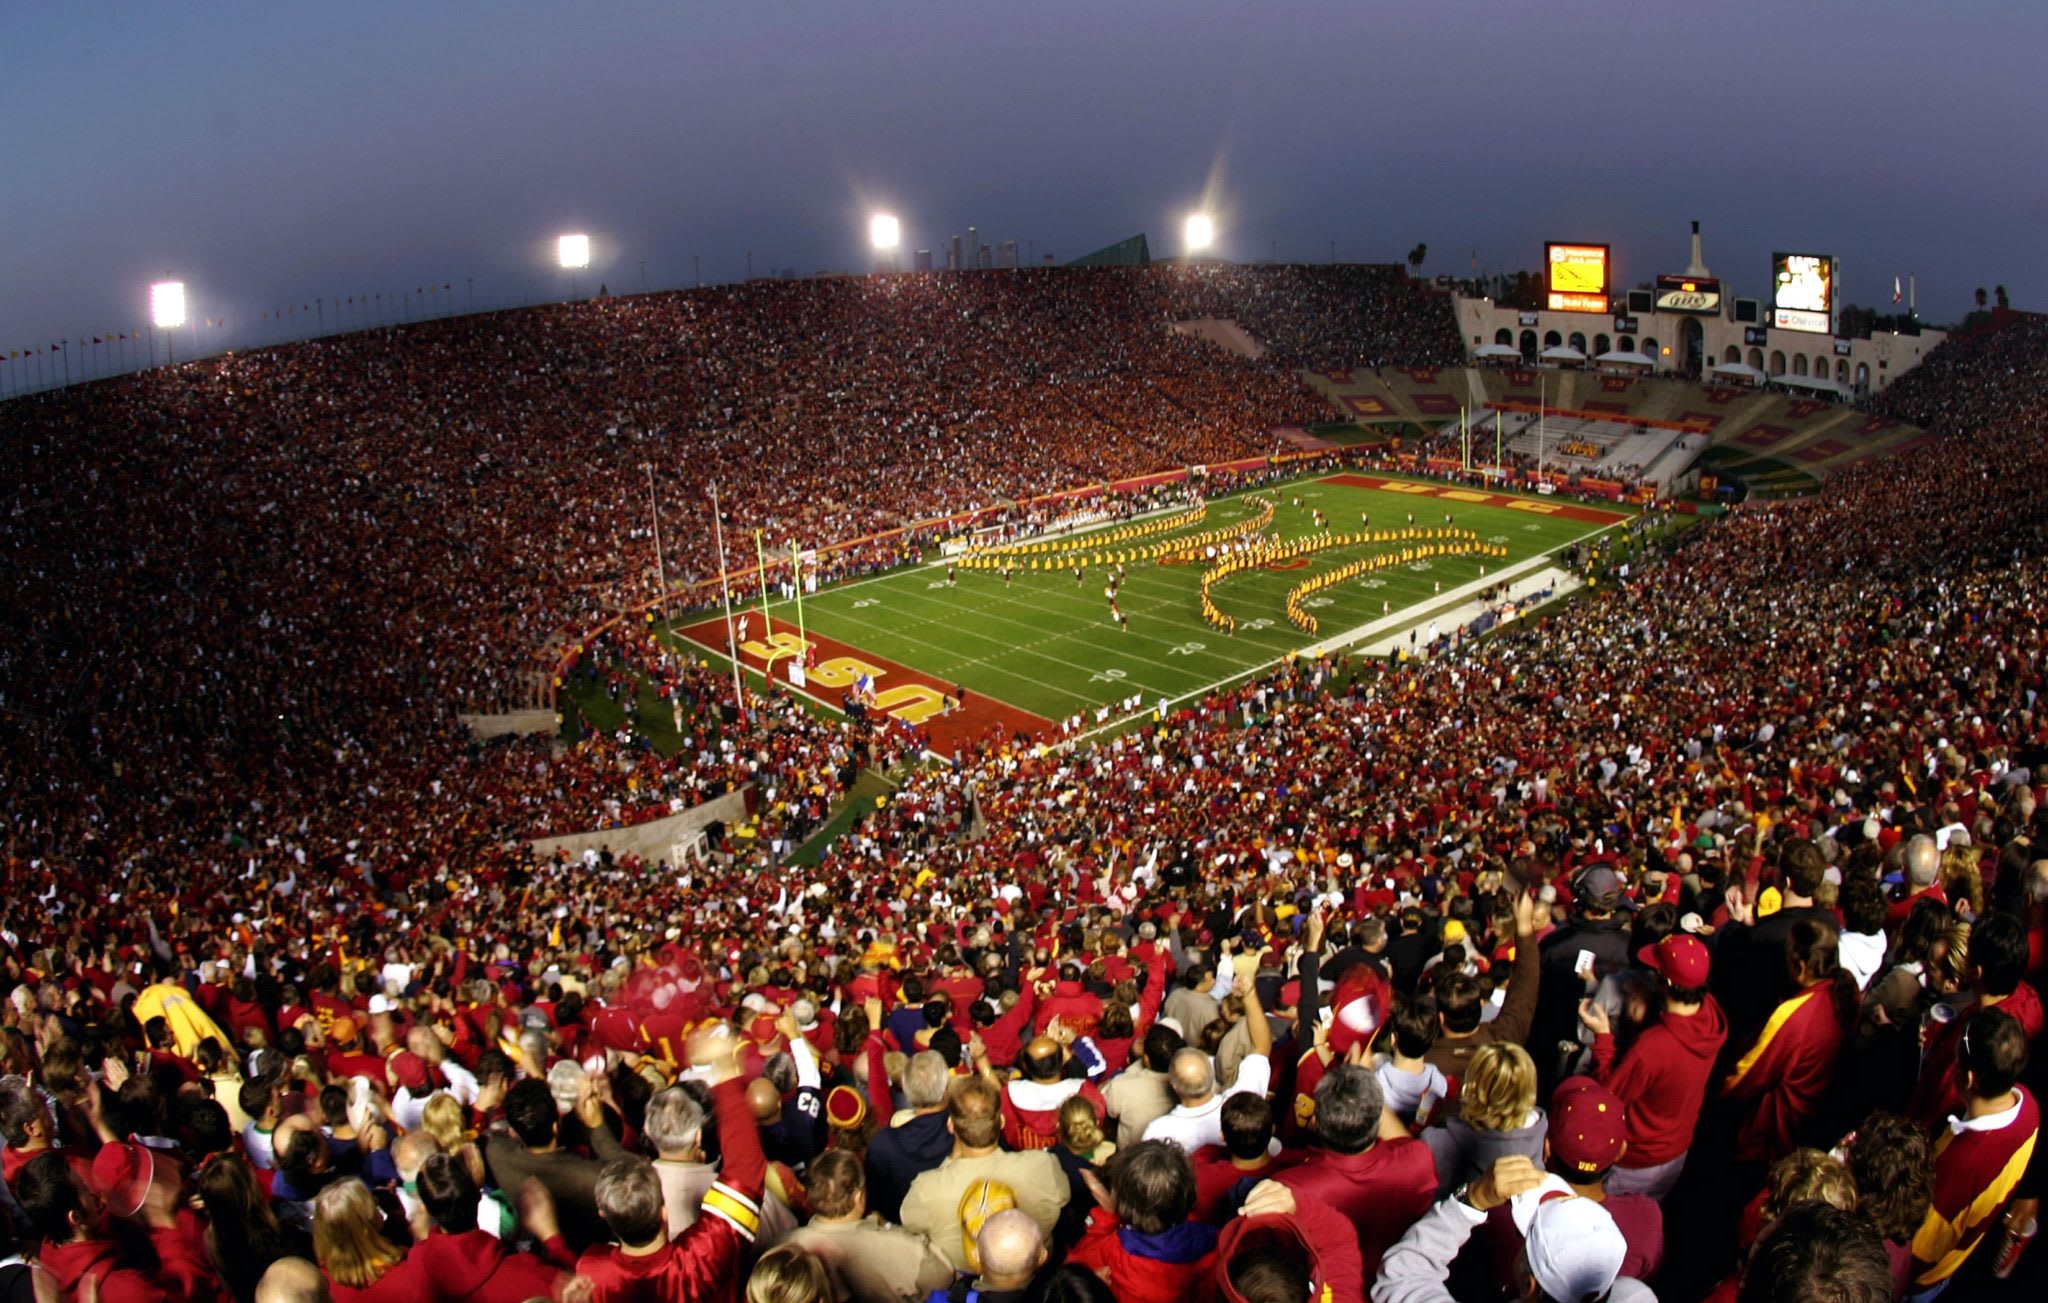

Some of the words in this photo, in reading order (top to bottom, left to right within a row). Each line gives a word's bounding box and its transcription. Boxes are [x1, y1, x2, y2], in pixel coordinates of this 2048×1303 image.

[1792, 315, 1827, 328] Chevron
[739, 632, 960, 725] USC
[1578, 1161, 1598, 1172] USC
